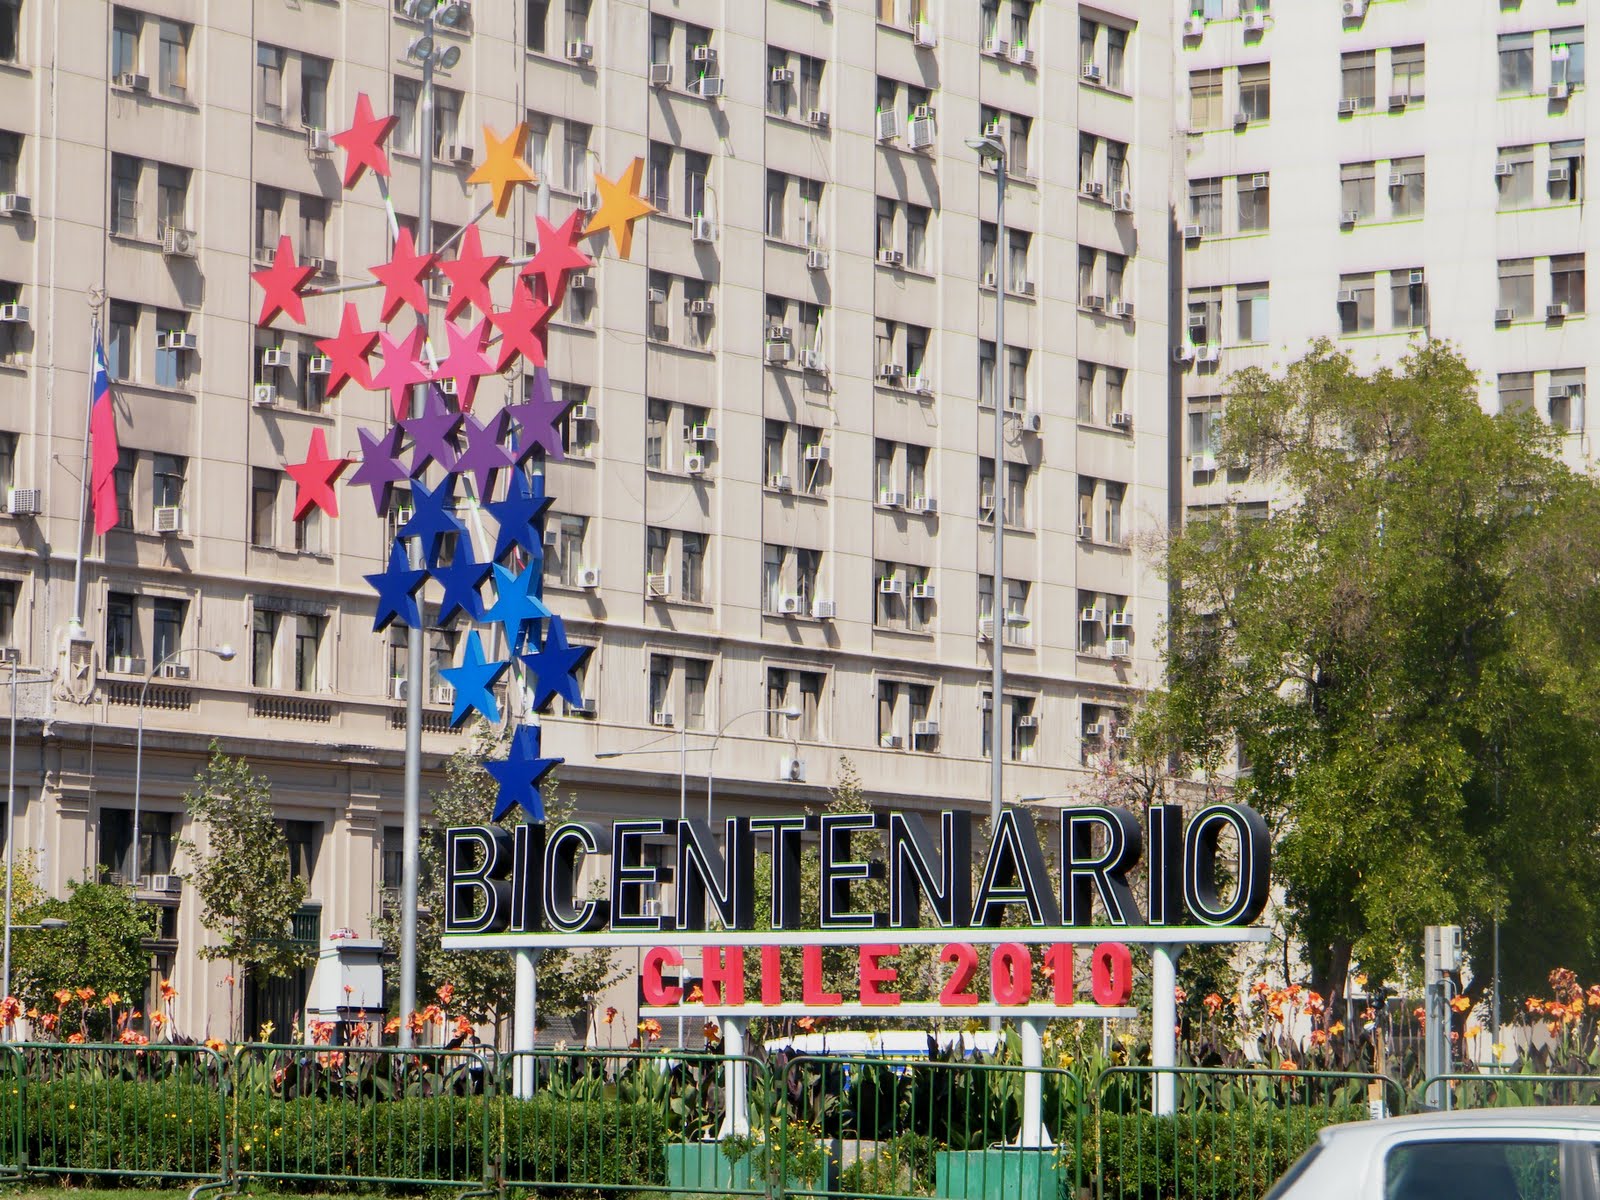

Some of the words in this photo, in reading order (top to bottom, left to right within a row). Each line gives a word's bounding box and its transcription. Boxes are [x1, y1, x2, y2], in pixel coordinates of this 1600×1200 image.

[445, 803, 1271, 932] BICENTENARIO
[643, 944, 895, 1006] CHILE
[941, 942, 1133, 1006] 2010
